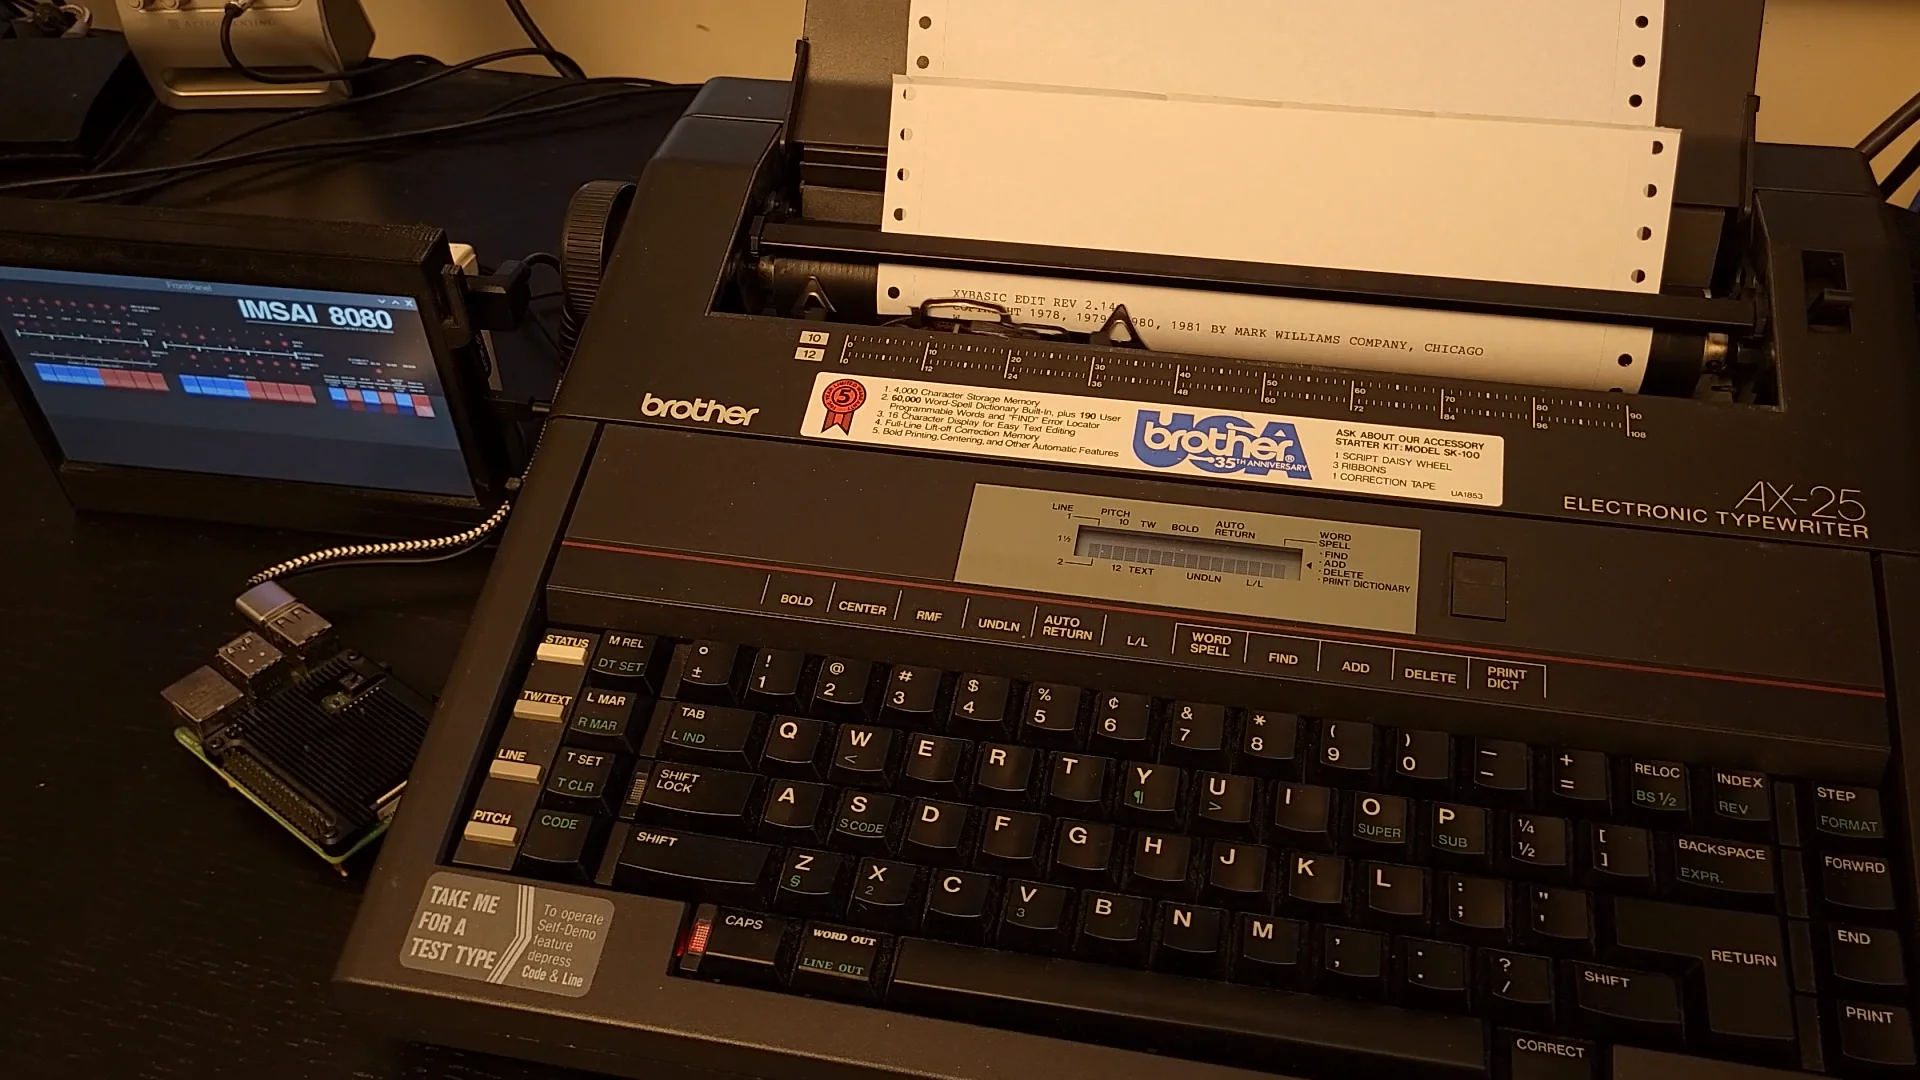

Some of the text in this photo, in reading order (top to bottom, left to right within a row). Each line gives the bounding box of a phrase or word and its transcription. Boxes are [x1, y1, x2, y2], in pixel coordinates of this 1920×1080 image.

[166, 281, 212, 292] FrontPanel
[953, 289, 1007, 302] XYBASIC
[1014, 294, 1046, 306] EDIT
[1053, 298, 1078, 308] REV
[238, 299, 393, 329] IMSAI 8080
[807, 333, 822, 343] 10
[1030, 309, 1067, 322] 1978,
[1131, 317, 1161, 330] 980,
[1171, 320, 1201, 332] 1981
[1211, 324, 1227, 334] BY
[1234, 327, 1267, 338] MARK
[1275, 330, 1341, 345] WILLIAMS
[1349, 336, 1414, 352] COMPANY,
[1424, 343, 1484, 356] CHICAGO
[803, 350, 817, 359] 12
[836, 388, 850, 403] 5
[893, 386, 1040, 407] 4,000 Character Storage Memory
[641, 392, 760, 426] brother
[890, 403, 953, 415] Programmable
[957, 409, 985, 418] Words
[988, 412, 1005, 420] and
[1041, 417, 1063, 425] Error
[1067, 420, 1100, 429] Locator
[892, 394, 921, 403] 60,000
[925, 397, 972, 408] Word-Spell
[976, 402, 1019, 413] Dictionary
[1057, 410, 1076, 419] plus
[1080, 412, 1096, 420] 190
[1100, 413, 1121, 422] User
[885, 419, 1040, 442] Full-Line Lift-off Correction Memory
[902, 413, 1076, 437] Character Display Easy Text Editing
[883, 428, 903, 436] Bold
[940, 434, 985, 445] Centering,
[1005, 439, 1031, 448] Other
[1032, 443, 1077, 453] Automatic
[1079, 447, 1119, 457] Features
[1144, 421, 1293, 462] brother
[1336, 429, 1484, 450] ASK ABOUT OUR ACCESSORY
[1335, 438, 1481, 459] STARTER KIT: MODEL SK-100
[1214, 456, 1308, 472] 35TH ANNIVERSARY
[1342, 462, 1387, 474] RIBBONS
[1343, 452, 1452, 471] SCRIPT DAISY WHEEL
[1340, 473, 1436, 490] CORRECTION TAPE
[1451, 490, 1483, 500] UA1853
[1735, 481, 1866, 522] AX-25
[1051, 502, 1074, 512] LINE
[1101, 508, 1131, 518] PITCH
[1140, 520, 1157, 529] TW
[1215, 520, 1245, 530] AUTO
[1564, 496, 1869, 539] ELECTRONIC TYPEWRITER
[1171, 523, 1200, 533] BOLD
[1214, 528, 1256, 540] RETURN
[1318, 539, 1351, 550] SPELL
[1319, 531, 1352, 542] WORD
[1324, 551, 1349, 561] FIND
[1128, 566, 1155, 576] TEXT
[1323, 560, 1347, 569] ADD
[1186, 572, 1222, 583] UNDLN
[1323, 569, 1364, 579] DELETE
[1246, 579, 1264, 588] L/L
[1322, 577, 1411, 594] PRINT DICTIONARY
[780, 594, 814, 607] BOLD
[838, 600, 887, 616] CENTER
[916, 610, 944, 622] RMF
[1044, 614, 1081, 627] AUTO
[978, 618, 1021, 632] UNDLN
[1042, 625, 1094, 641] RETURN
[545, 634, 590, 649] STATUS
[608, 635, 645, 649] M REL
[1127, 635, 1149, 648] L/L
[1191, 631, 1232, 646] WORD
[1189, 643, 1231, 657] SPELL
[1268, 652, 1299, 666] FIND
[1341, 661, 1371, 674] ADD
[1487, 666, 1528, 680] PRINT
[1404, 668, 1457, 684] DELETE
[1486, 677, 1520, 691] DICT
[523, 690, 572, 706] TW/TEXT
[586, 692, 627, 707] L MAR
[681, 707, 706, 720] TAB
[498, 749, 527, 762] LINE
[567, 752, 603, 768] T SET
[660, 768, 700, 784] SHIFT
[1634, 762, 1680, 779] RELOC
[656, 779, 693, 794] LOCK
[1716, 772, 1764, 789] INDEX
[1817, 786, 1856, 802] STEP
[473, 810, 512, 825] PITCH
[541, 814, 579, 830] CODE
[1820, 815, 1878, 833] FORMAT
[1358, 822, 1402, 839] SUPER
[636, 831, 679, 847] SHIFT
[1678, 838, 1767, 860] BACKSPACE
[1824, 855, 1886, 874] FORWRD
[429, 885, 501, 915] TAKE ME
[543, 903, 604, 926] To operate
[725, 914, 764, 930] CAPS
[417, 911, 467, 936] FOR A
[537, 919, 597, 941] Self-Demo
[533, 934, 573, 952] feature
[812, 928, 877, 947] WORD OUT
[1837, 929, 1871, 946] END
[409, 937, 497, 970] TEST TYPE
[527, 950, 572, 969] depress
[1711, 949, 1777, 968] RETURN
[803, 957, 865, 976] LINE OUT
[521, 964, 584, 988] Code & Line
[1584, 970, 1631, 989] SHIFT
[1845, 1005, 1894, 1025] PRINT
[1516, 1037, 1585, 1059] CORRECT
